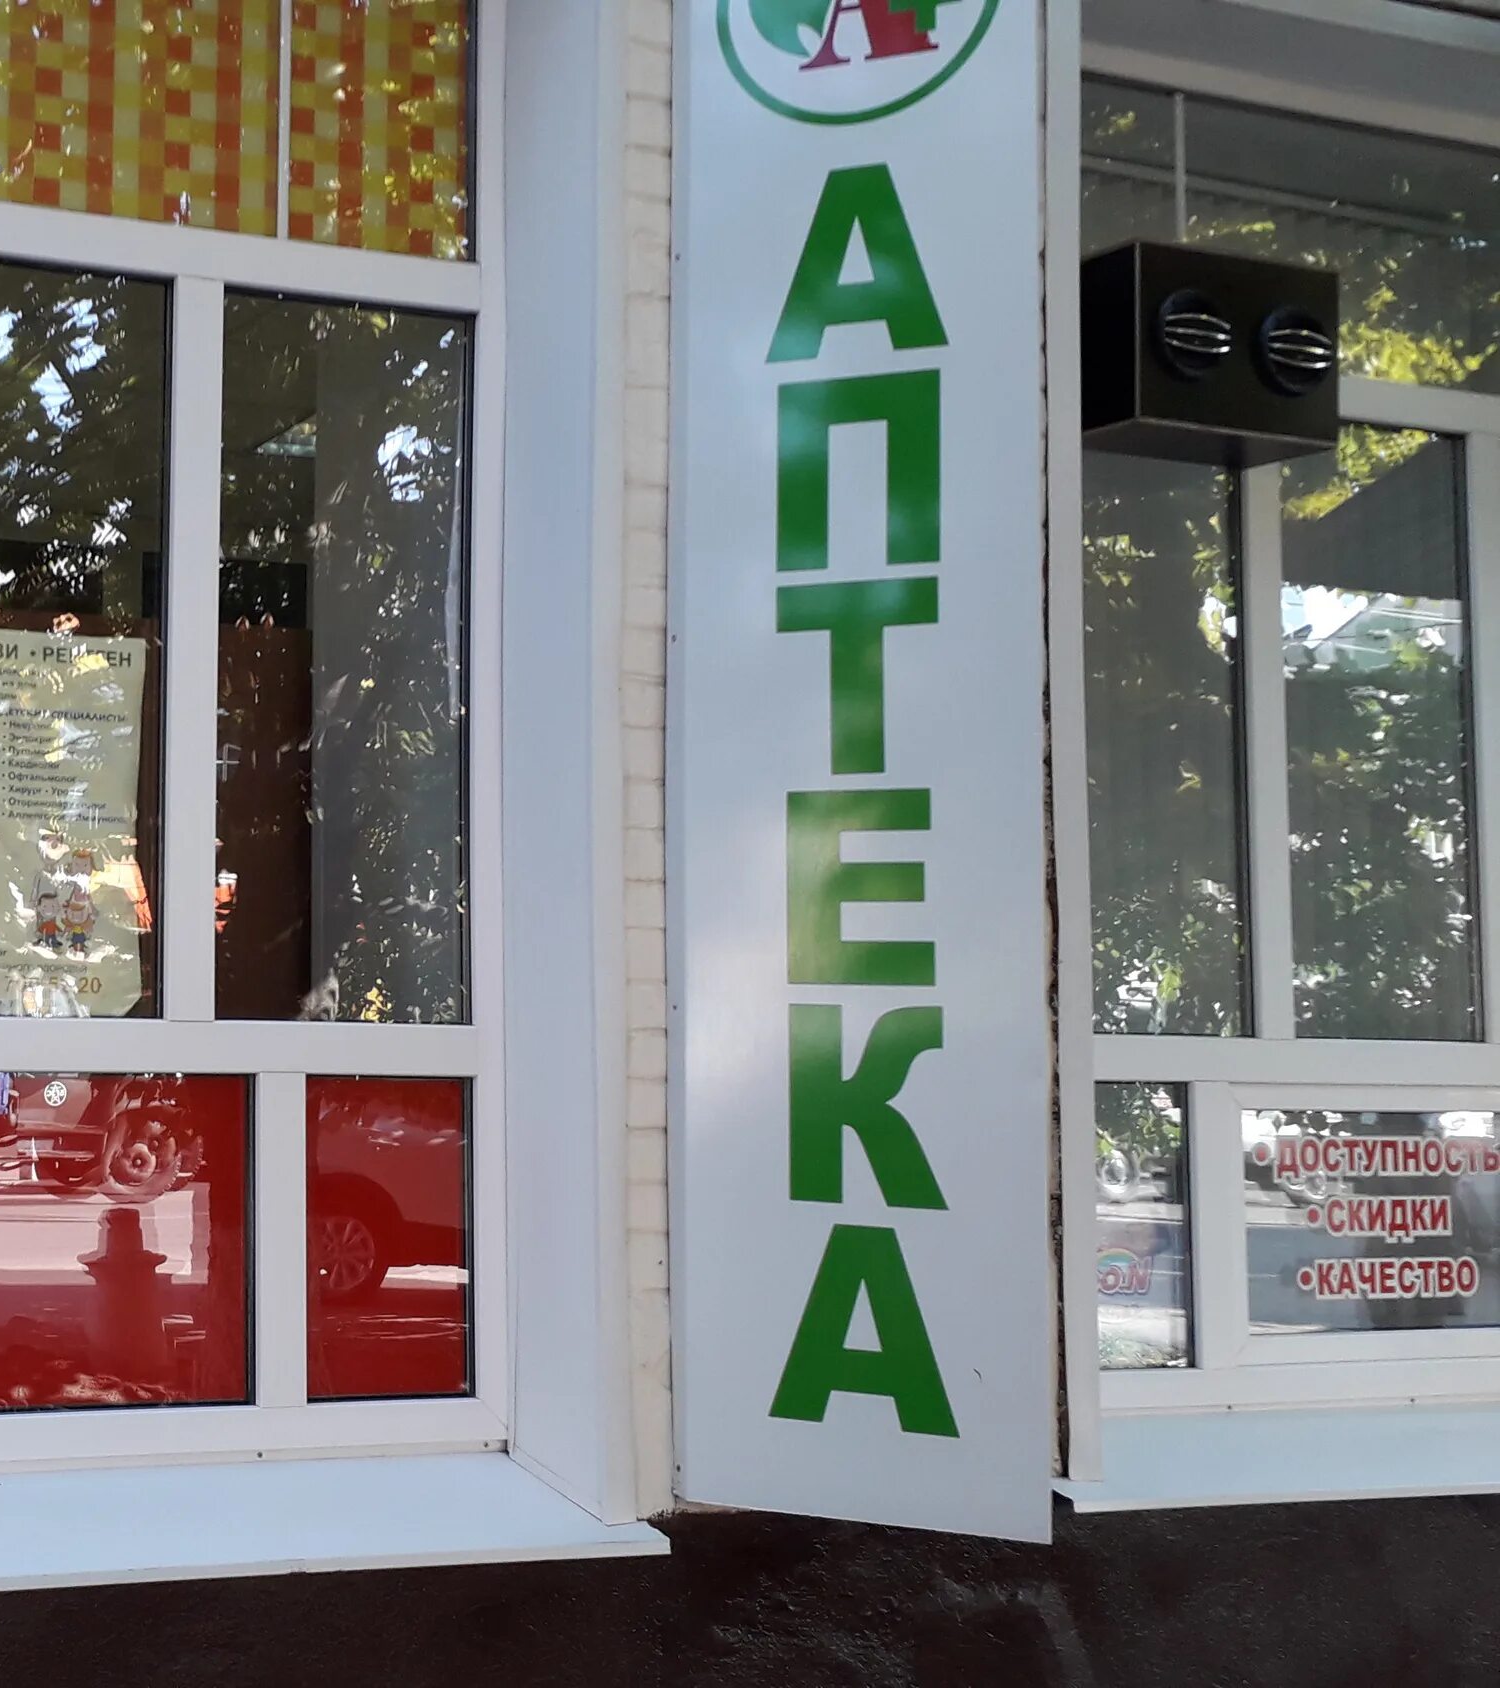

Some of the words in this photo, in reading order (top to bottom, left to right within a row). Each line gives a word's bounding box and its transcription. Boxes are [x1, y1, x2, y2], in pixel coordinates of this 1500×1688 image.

[764, 161, 961, 1439] АПТЕКА
[1275, 1138, 1500, 1180] ДОСТУПНОСТЬ
[1324, 1196, 1451, 1241] СКИДКИ
[1315, 1258, 1479, 1299] КАЧЕСТВО
